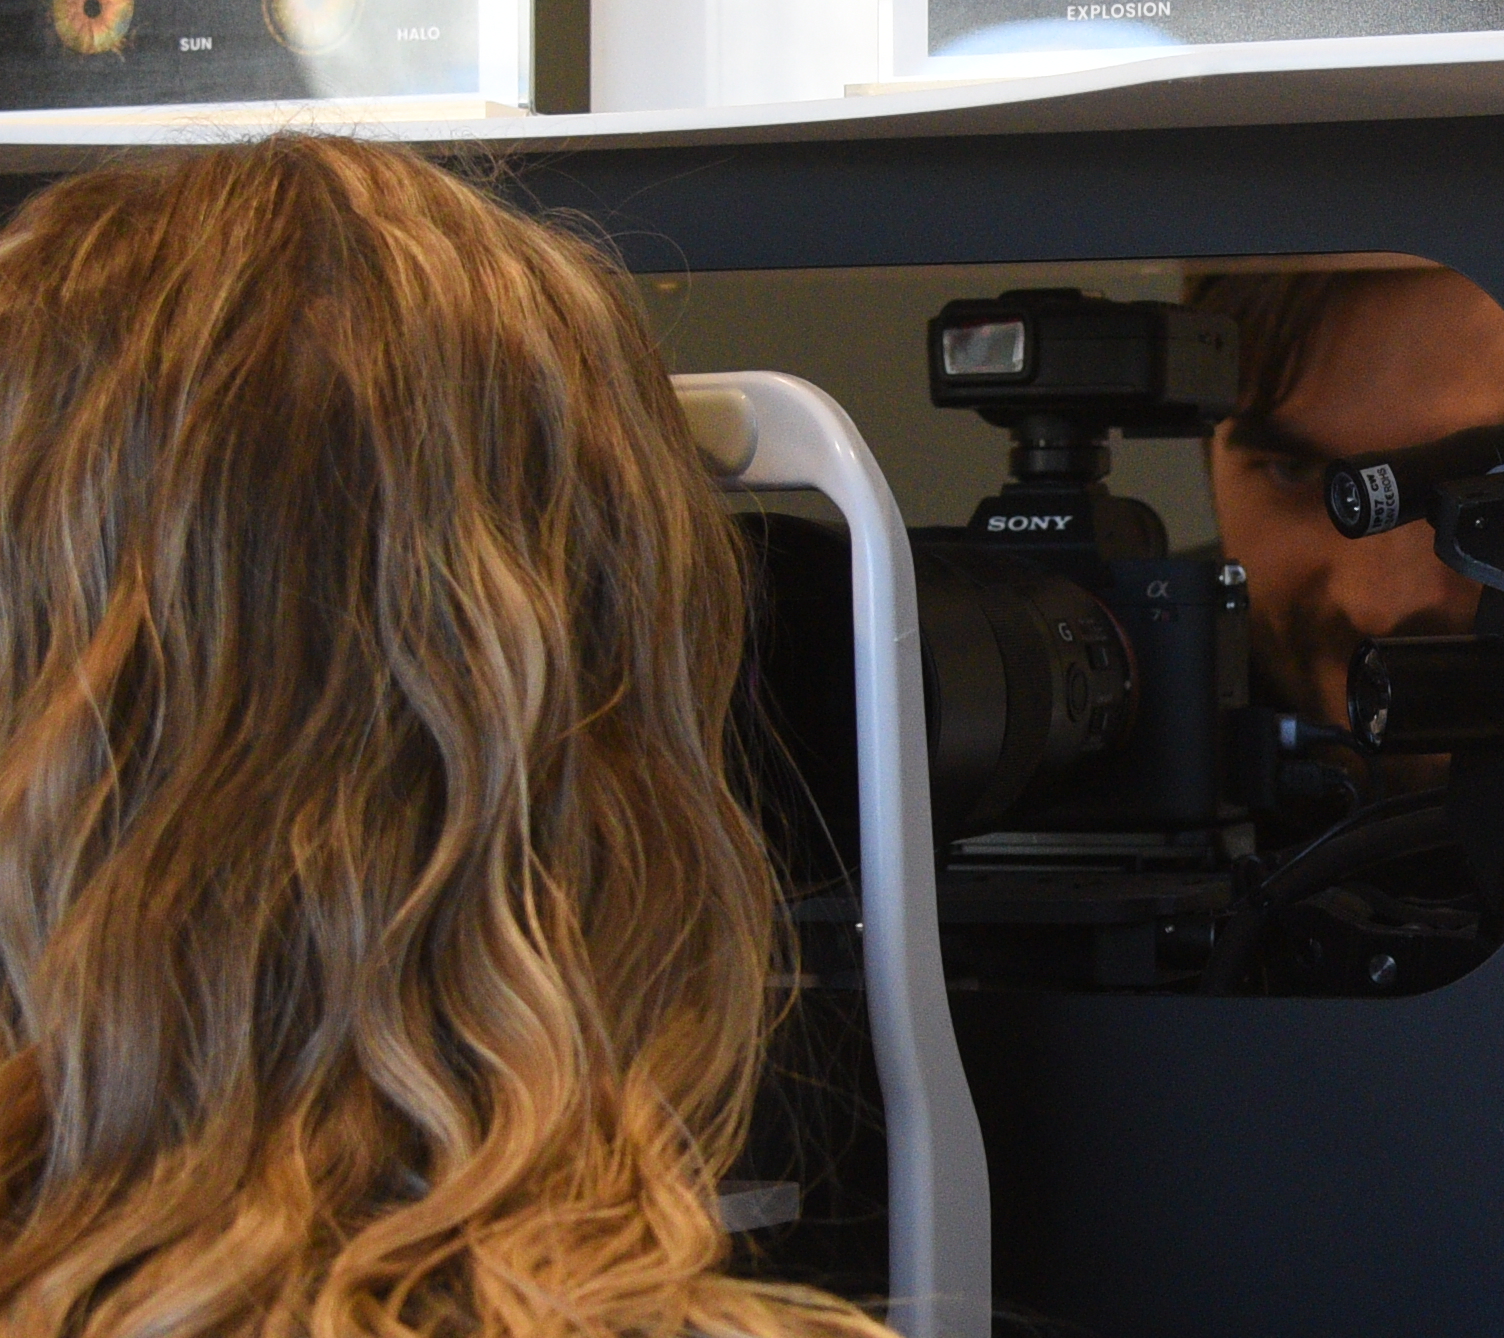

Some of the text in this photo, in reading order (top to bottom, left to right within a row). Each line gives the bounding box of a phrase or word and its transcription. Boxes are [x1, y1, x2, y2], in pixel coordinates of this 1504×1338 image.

[1065, 0, 1173, 23] EXPLOSION
[395, 24, 442, 43] HALO
[178, 36, 214, 53] SUN
[987, 514, 1073, 533] SONY
[1058, 622, 1073, 642] G
